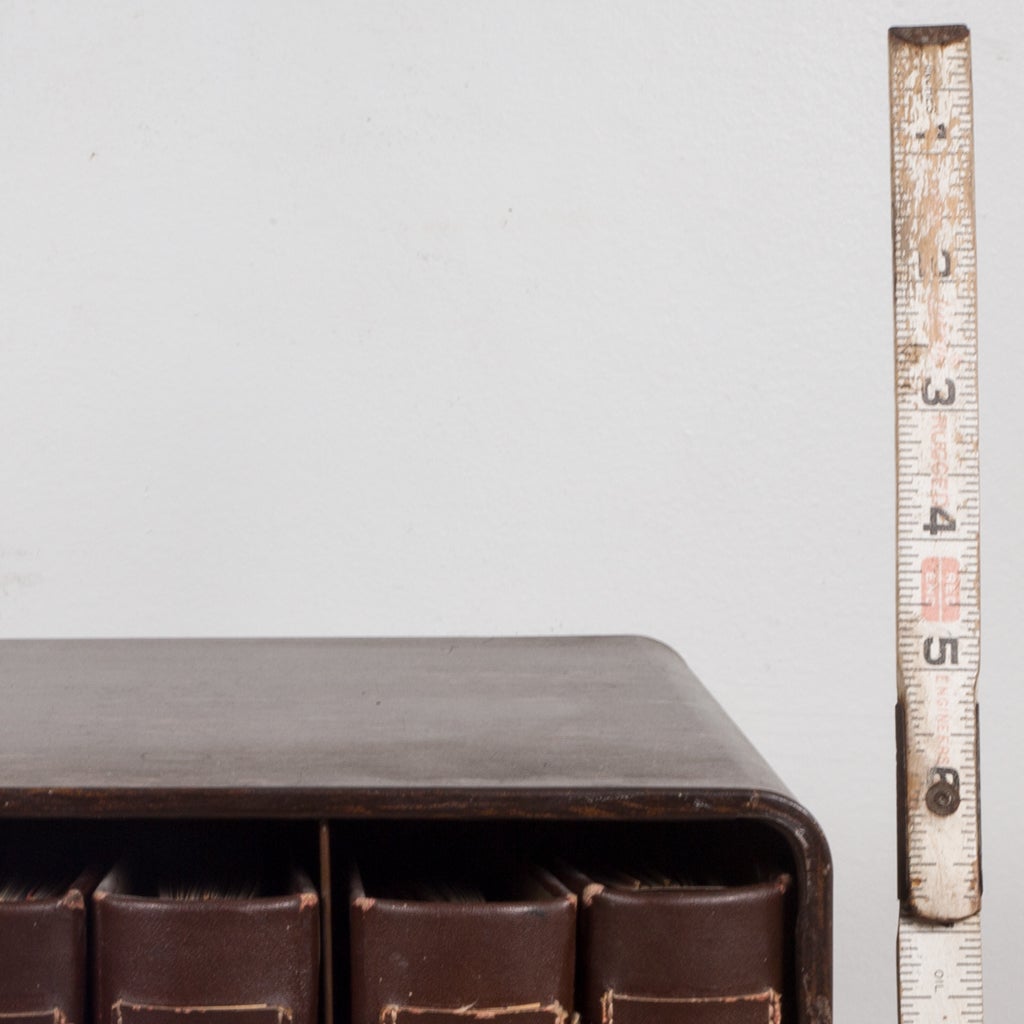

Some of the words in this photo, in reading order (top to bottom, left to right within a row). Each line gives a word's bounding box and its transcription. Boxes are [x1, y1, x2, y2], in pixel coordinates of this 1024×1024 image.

[920, 377, 956, 406] 3
[922, 505, 959, 535] 4
[923, 636, 959, 666] 5
[934, 969, 945, 992] OIL
